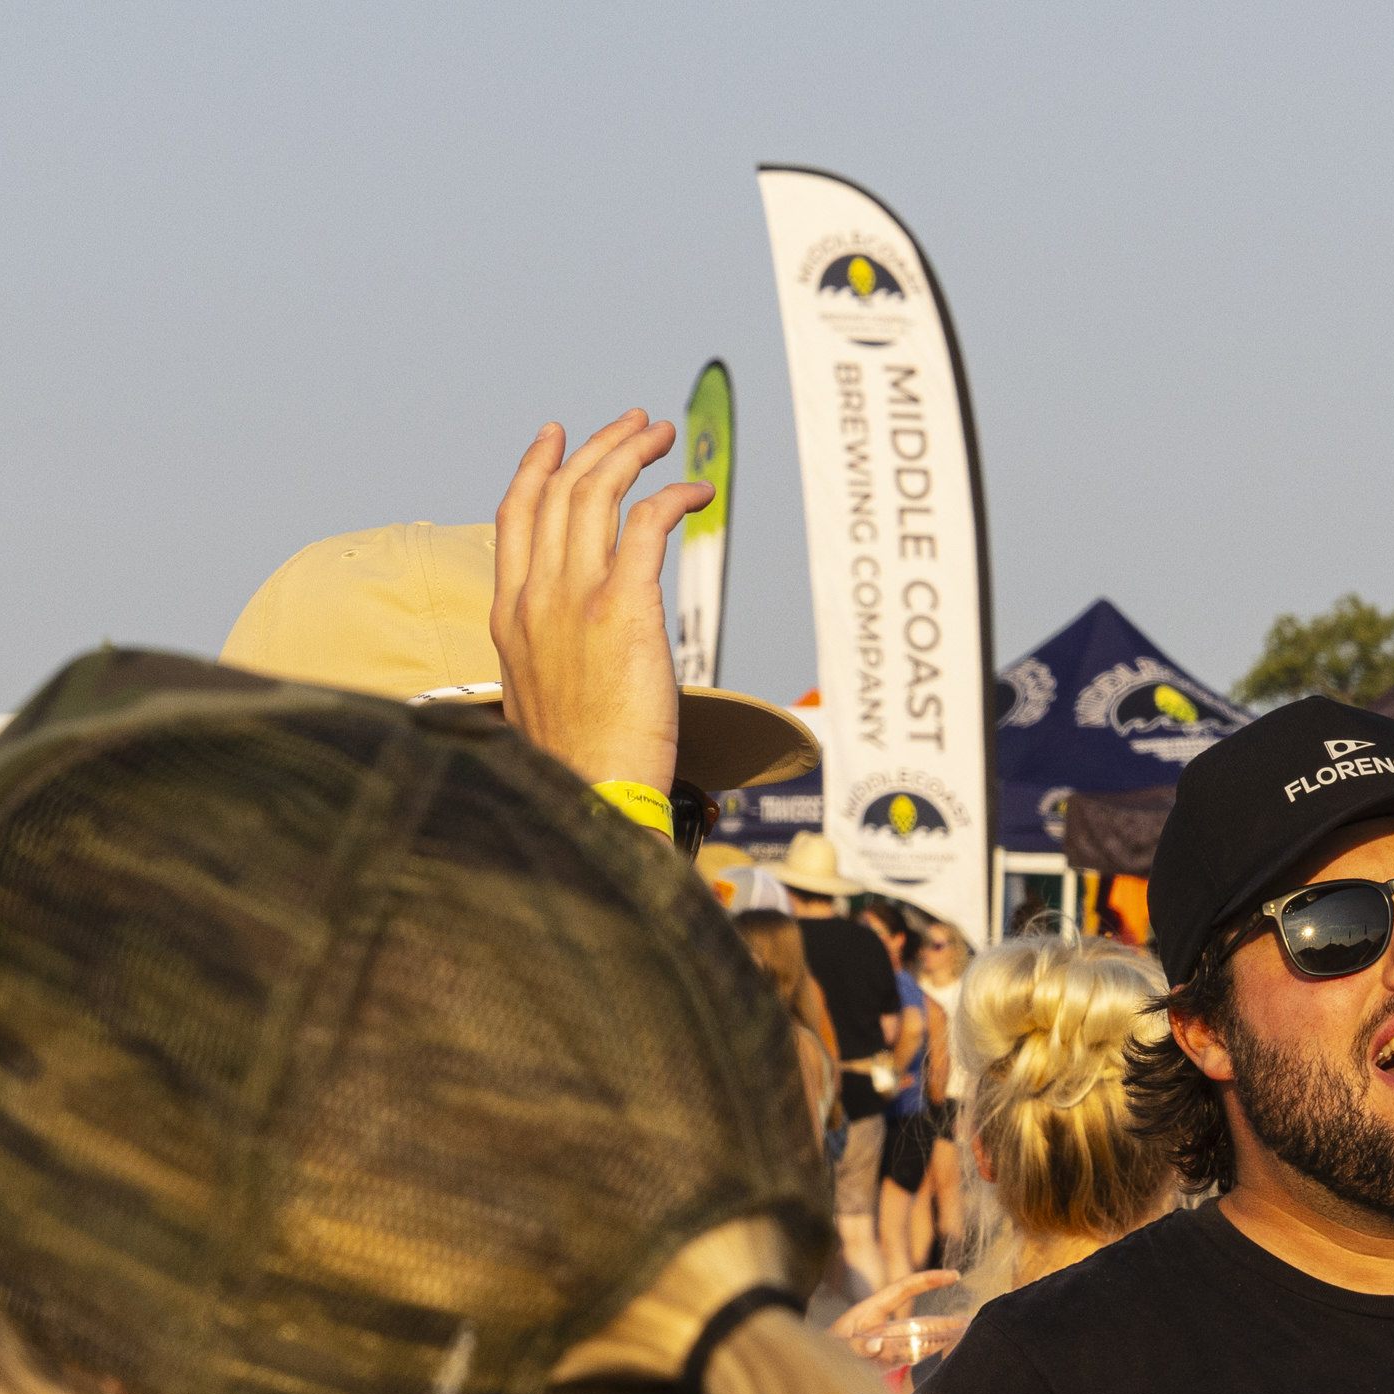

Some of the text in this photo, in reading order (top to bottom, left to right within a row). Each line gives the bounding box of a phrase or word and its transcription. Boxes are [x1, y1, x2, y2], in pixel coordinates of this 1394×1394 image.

[834, 361, 879, 545] BREWING
[851, 553, 889, 752] COMPANY
[883, 363, 947, 754] MIDDLE COAST
